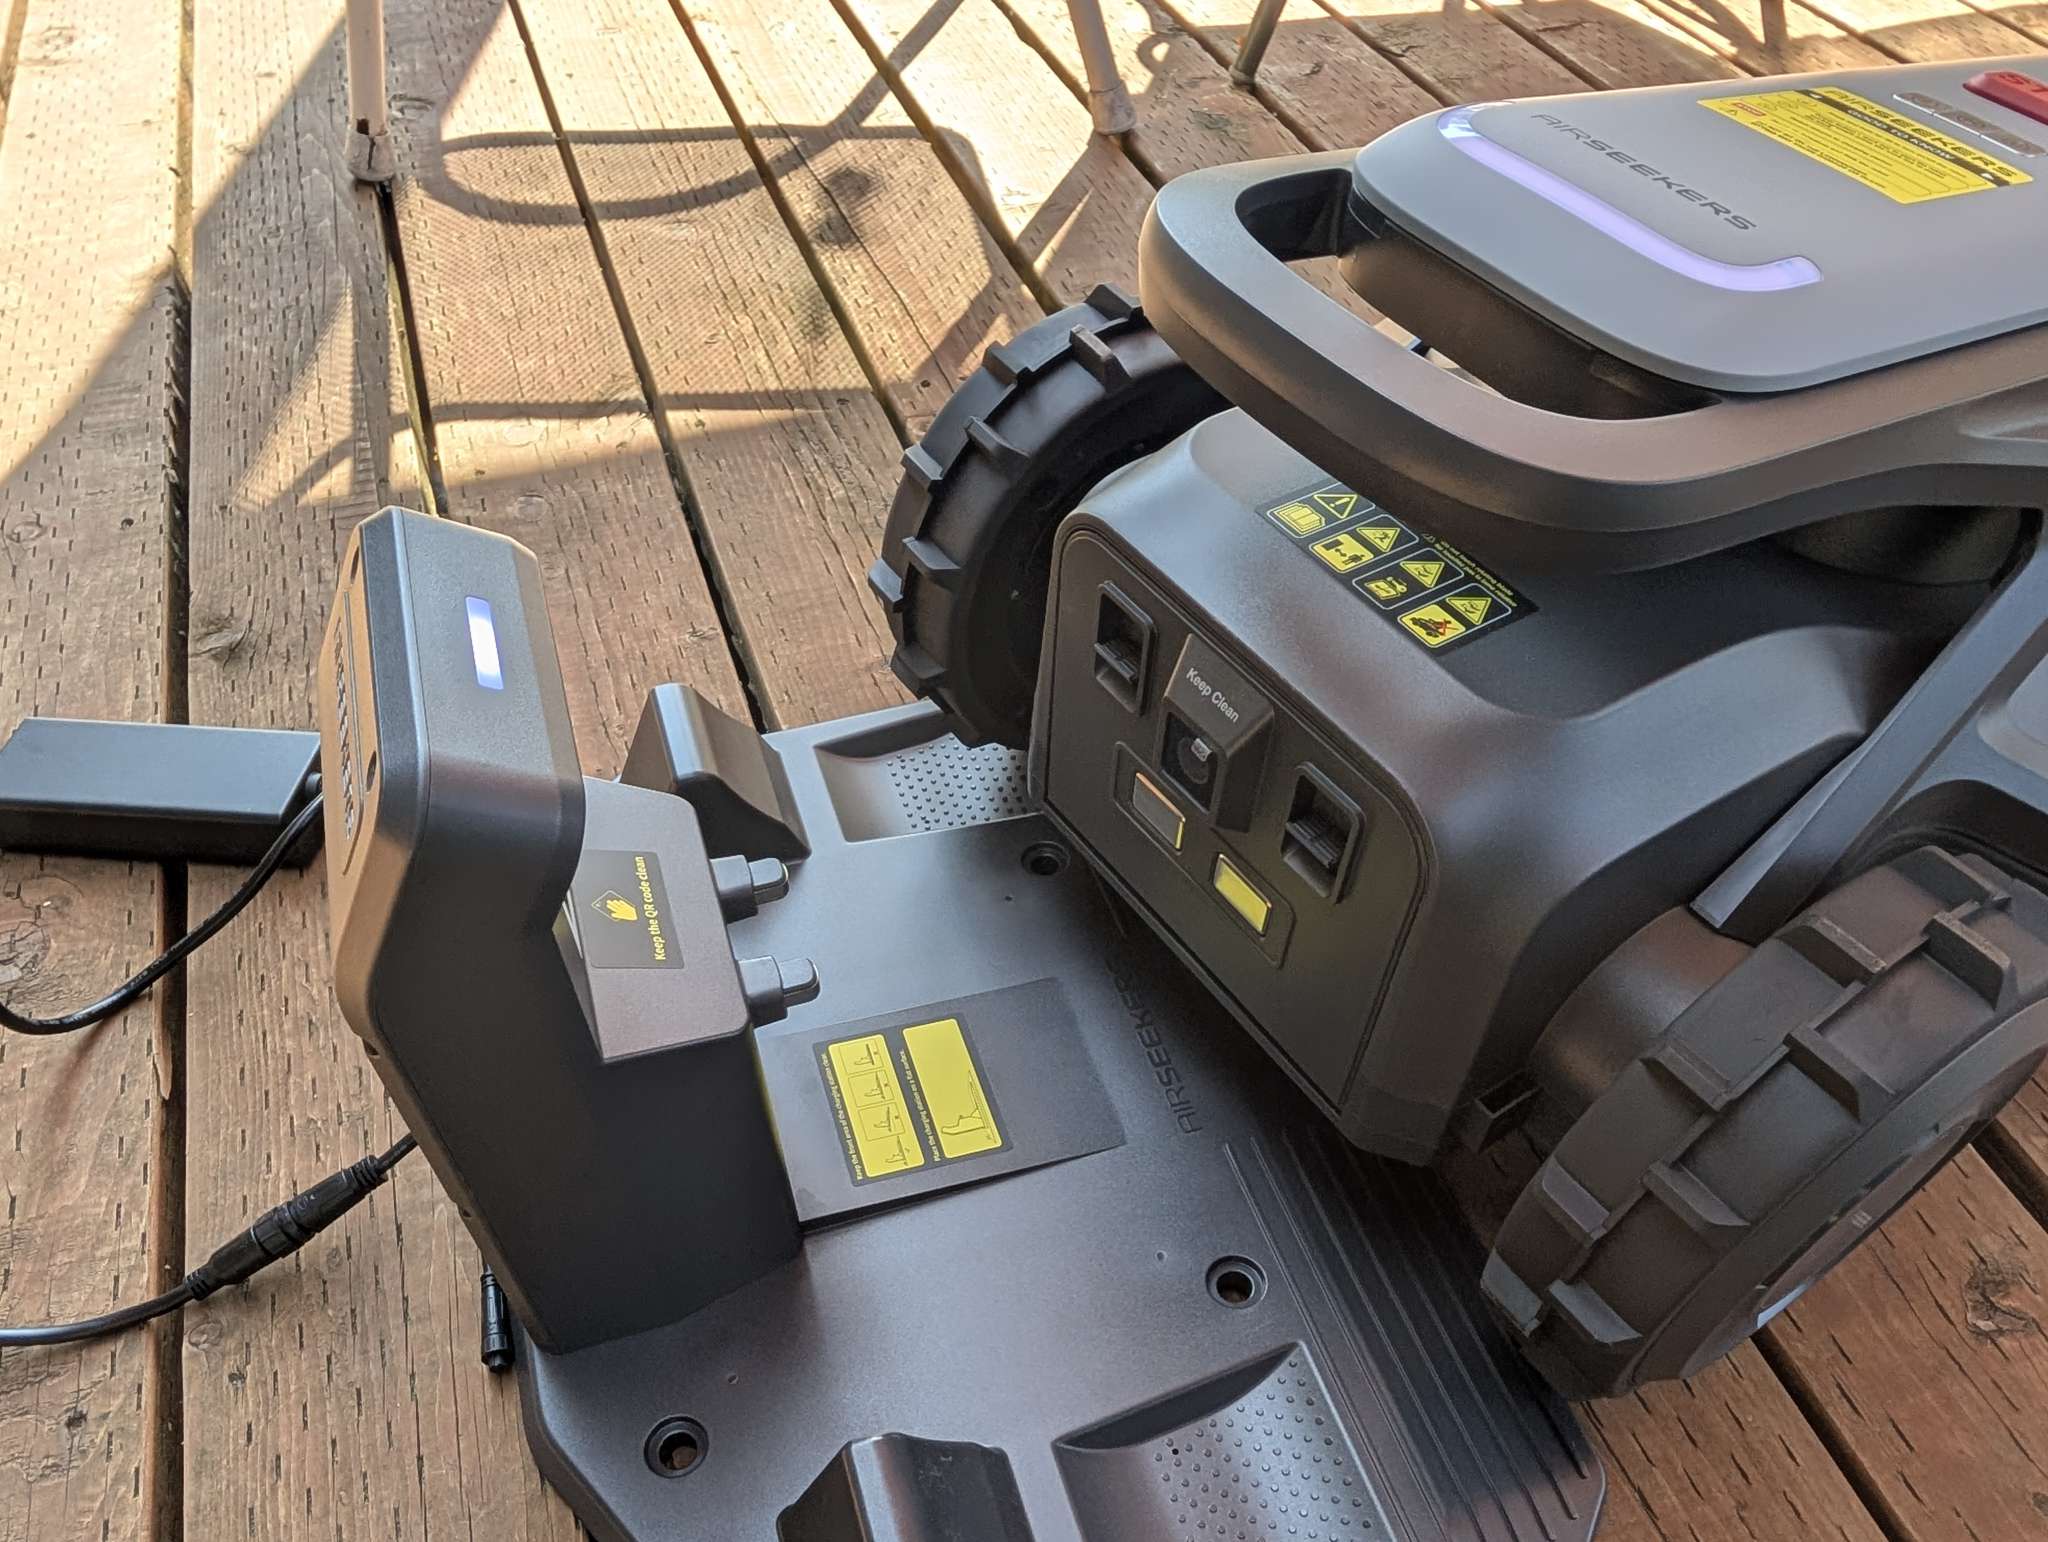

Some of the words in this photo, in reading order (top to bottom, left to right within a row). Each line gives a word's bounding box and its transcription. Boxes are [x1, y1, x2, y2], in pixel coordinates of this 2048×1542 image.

[1824, 89, 2017, 178] AIRSEEKERS
[1531, 113, 1757, 231] AIRSEEKERS
[1186, 667, 1212, 696] Keep
[1211, 691, 1240, 723] Clean
[635, 856, 648, 880] clean
[639, 881, 653, 902] code
[643, 903, 659, 919] QR
[648, 919, 661, 935] the
[653, 936, 667, 961] Keep
[1104, 956, 1203, 1134] AIRSEEKERS
[830, 1085, 843, 1109] charging
[913, 1091, 924, 1110] station
[919, 1110, 933, 1135] charging
[927, 1135, 935, 1145] the
[850, 1154, 858, 1164] the
[853, 1164, 864, 1179] Keep
